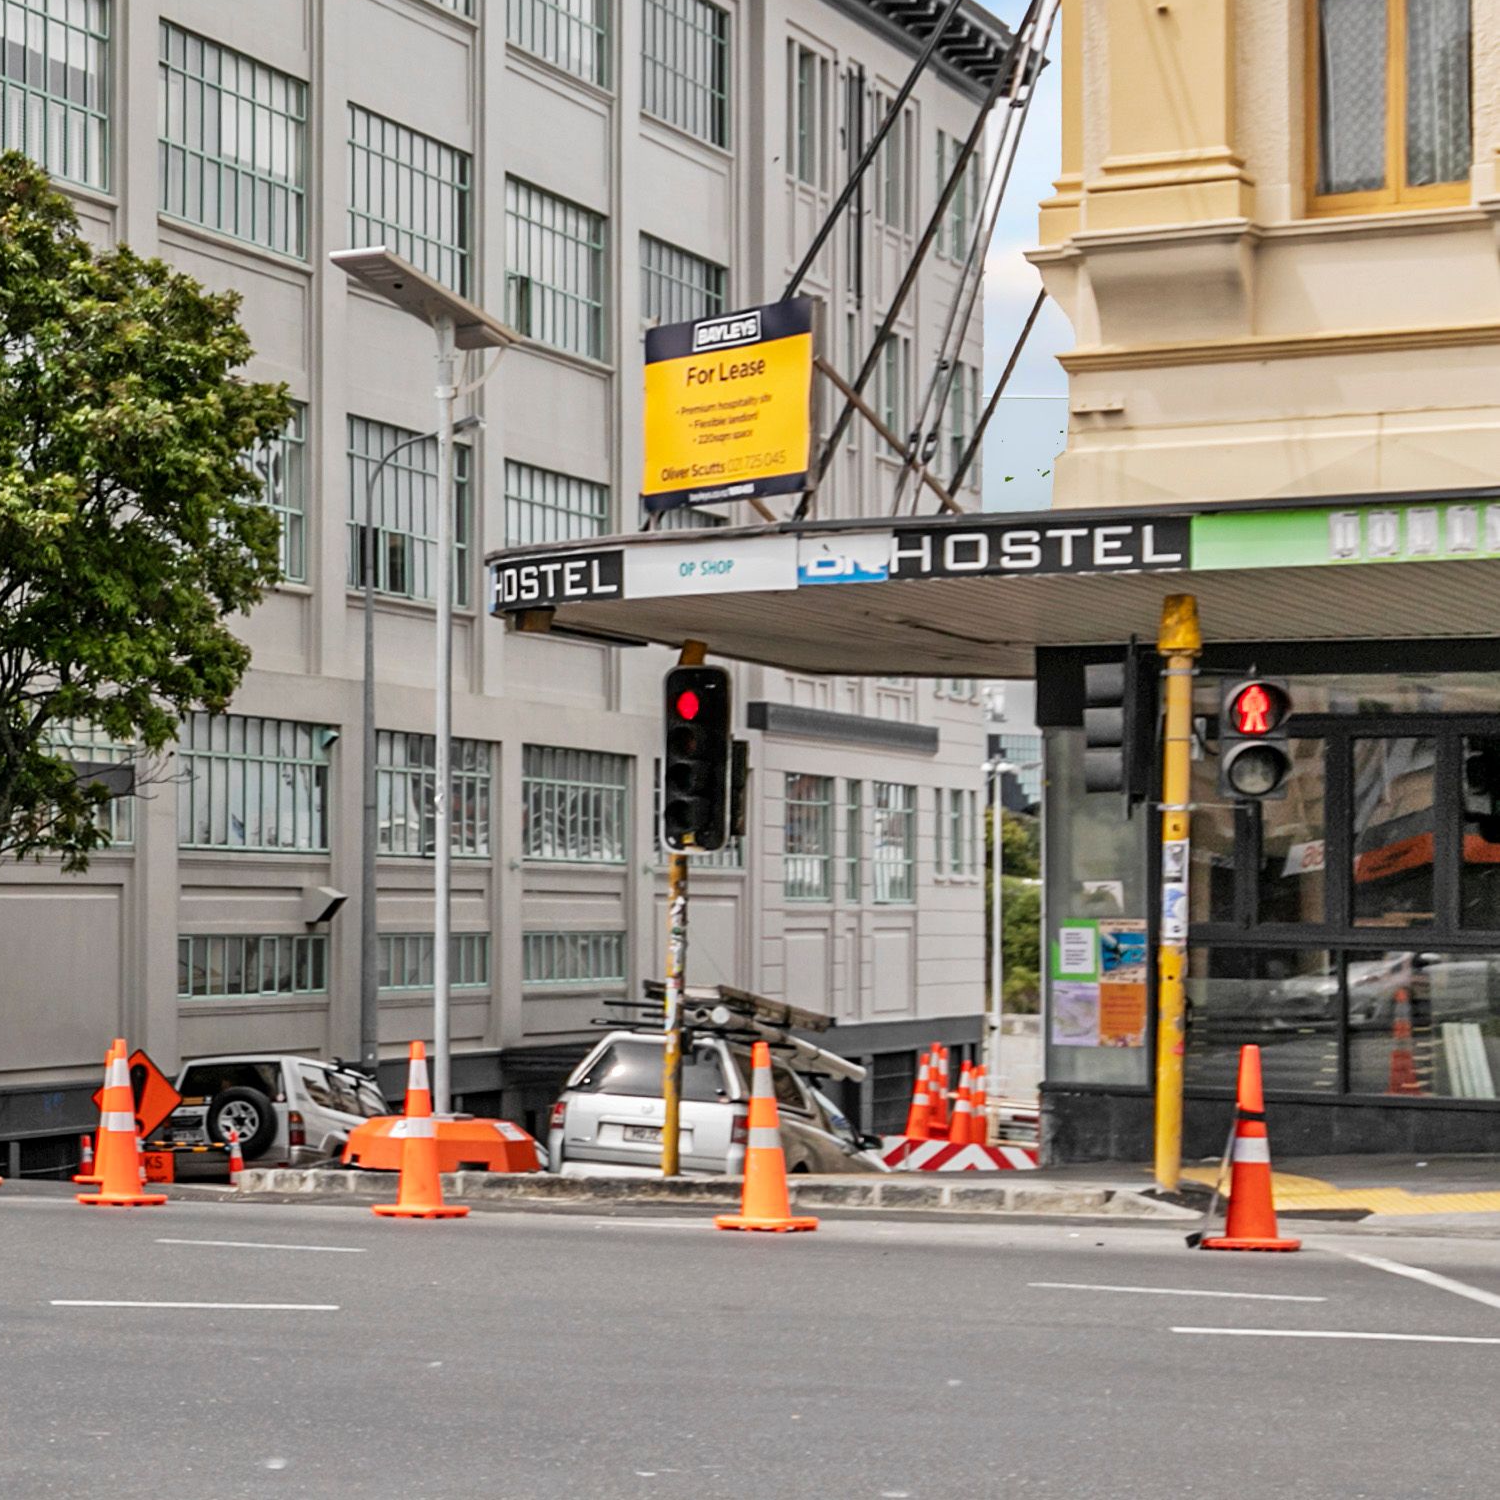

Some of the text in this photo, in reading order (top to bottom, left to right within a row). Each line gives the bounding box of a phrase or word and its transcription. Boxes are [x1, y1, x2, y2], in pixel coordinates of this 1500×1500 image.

[697, 318, 757, 346] BAYLEYS
[686, 358, 766, 387] For Lease
[680, 402, 718, 416] Premium
[661, 467, 690, 482] Oliver
[691, 460, 726, 477] Scutts
[890, 524, 1182, 574] HOSTEL
[679, 560, 735, 577] OP SHOP
